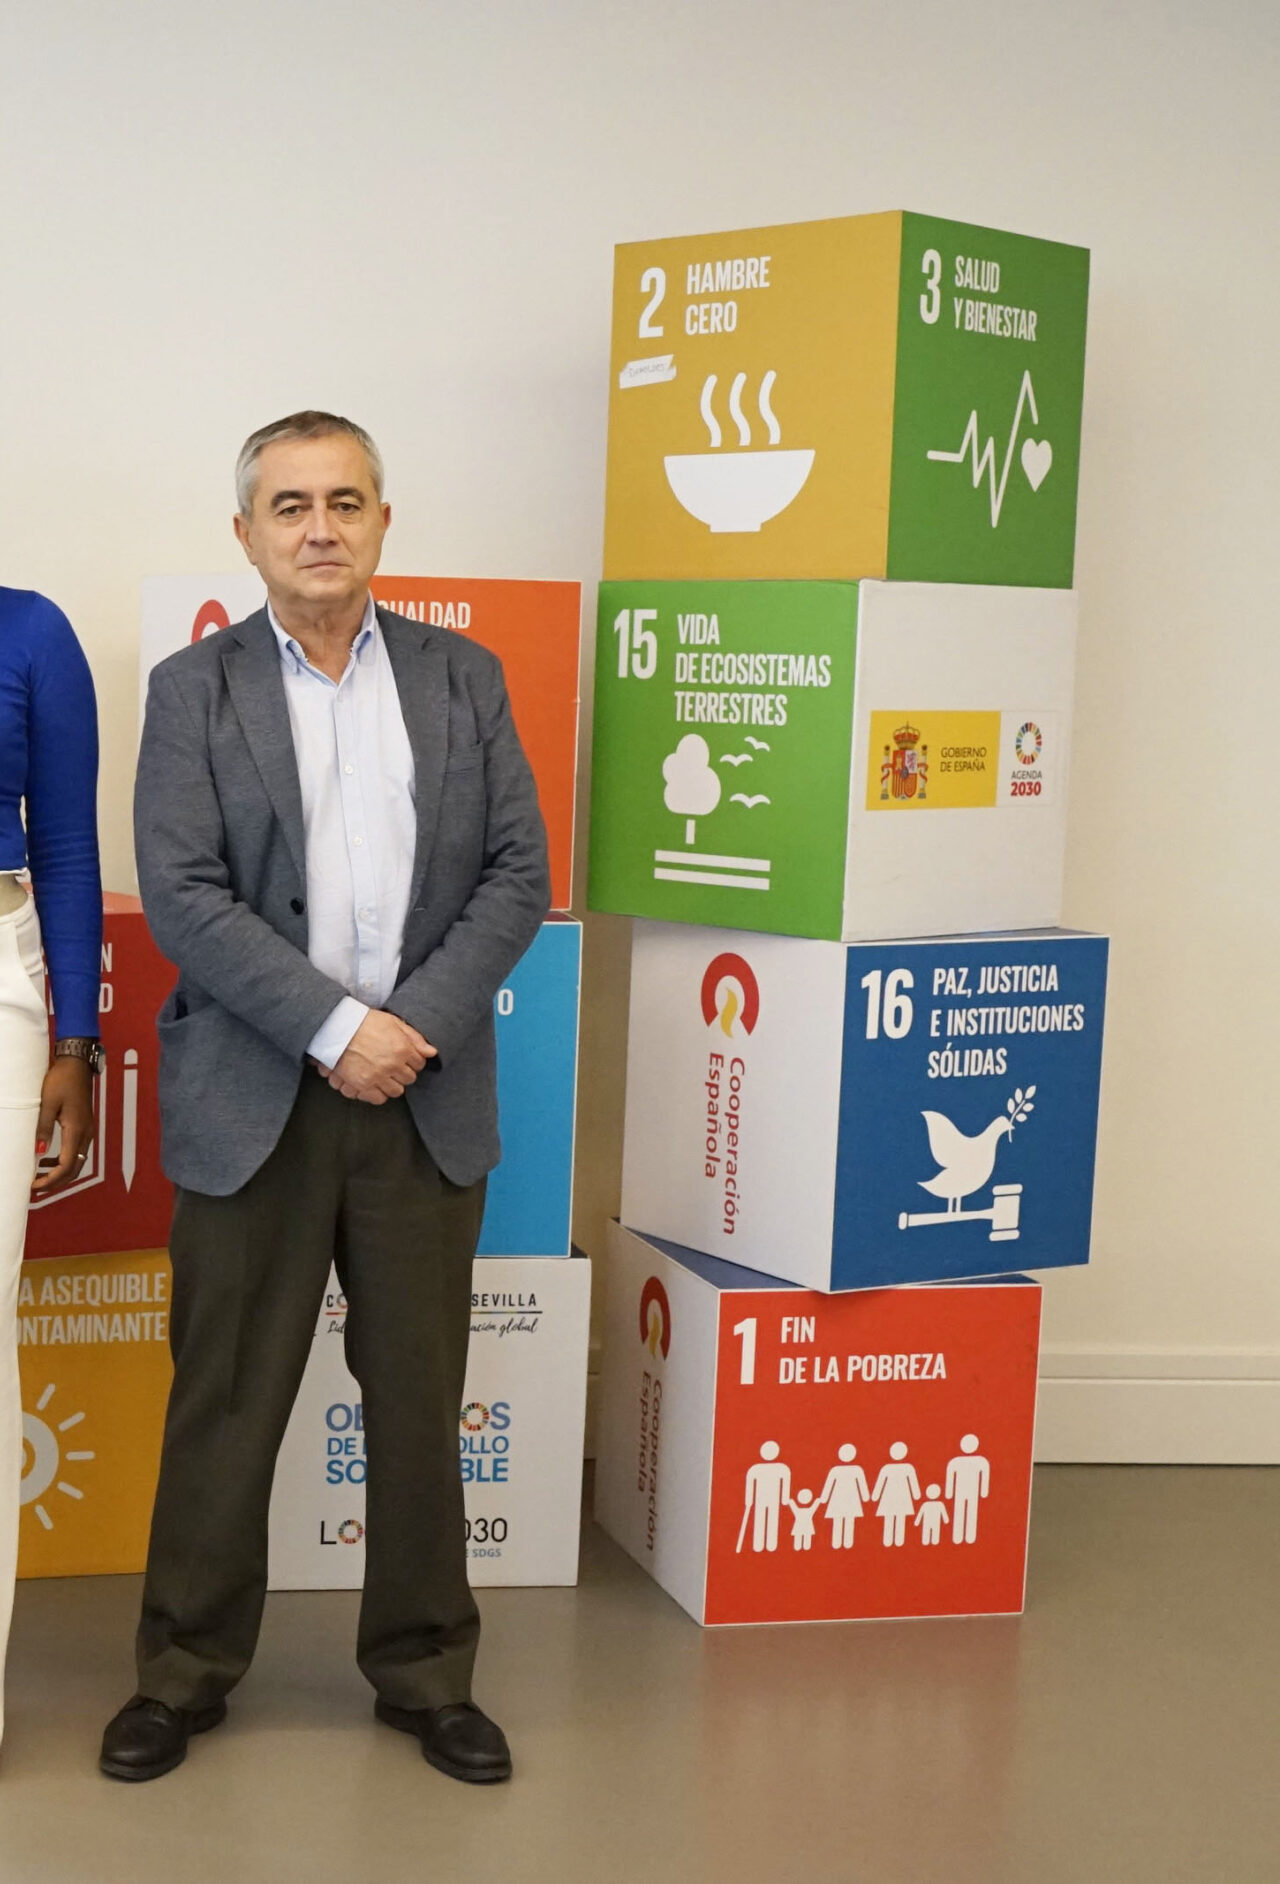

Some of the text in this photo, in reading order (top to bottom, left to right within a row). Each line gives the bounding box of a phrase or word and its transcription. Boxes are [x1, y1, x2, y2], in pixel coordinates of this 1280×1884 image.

[686, 256, 771, 295] HAMBRE
[920, 249, 942, 325] 3
[955, 255, 1000, 294] SALUD
[638, 267, 666, 339] 2
[685, 301, 738, 336] CERO
[954, 297, 1038, 342] Y BIENESTAR
[613, 608, 658, 680] 15
[677, 613, 720, 646] VIDA
[675, 653, 832, 688] DE ECOSISTEMAS
[674, 692, 788, 727] TERRESTRES
[940, 758, 985, 772] DE ESPAÑA
[941, 746, 987, 758] GOBIERNO
[1010, 781, 1042, 797] 2030
[1011, 770, 1042, 780] AGENDA
[932, 964, 1059, 998] PAZ, JUSTICIA
[860, 968, 915, 1040] 16
[931, 1004, 1085, 1037] E INSTITUCIONES
[927, 1043, 1008, 1079] SÓLIDAS
[705, 1052, 724, 1178] Española
[723, 1057, 745, 1235] Cooperación
[40, 1272, 167, 1306] ASEQUIBLE
[470, 1293, 537, 1307] SEVILLA
[17, 1312, 167, 1346] NTAMINANTE
[498, 1316, 538, 1338] global
[781, 1316, 815, 1344] FIN
[733, 1317, 758, 1385] 1
[779, 1353, 947, 1384] DE LA POBREZA
[327, 1437, 357, 1456] DE
[646, 1379, 662, 1551] Cooperación
[472, 1548, 502, 1558] SDGS
